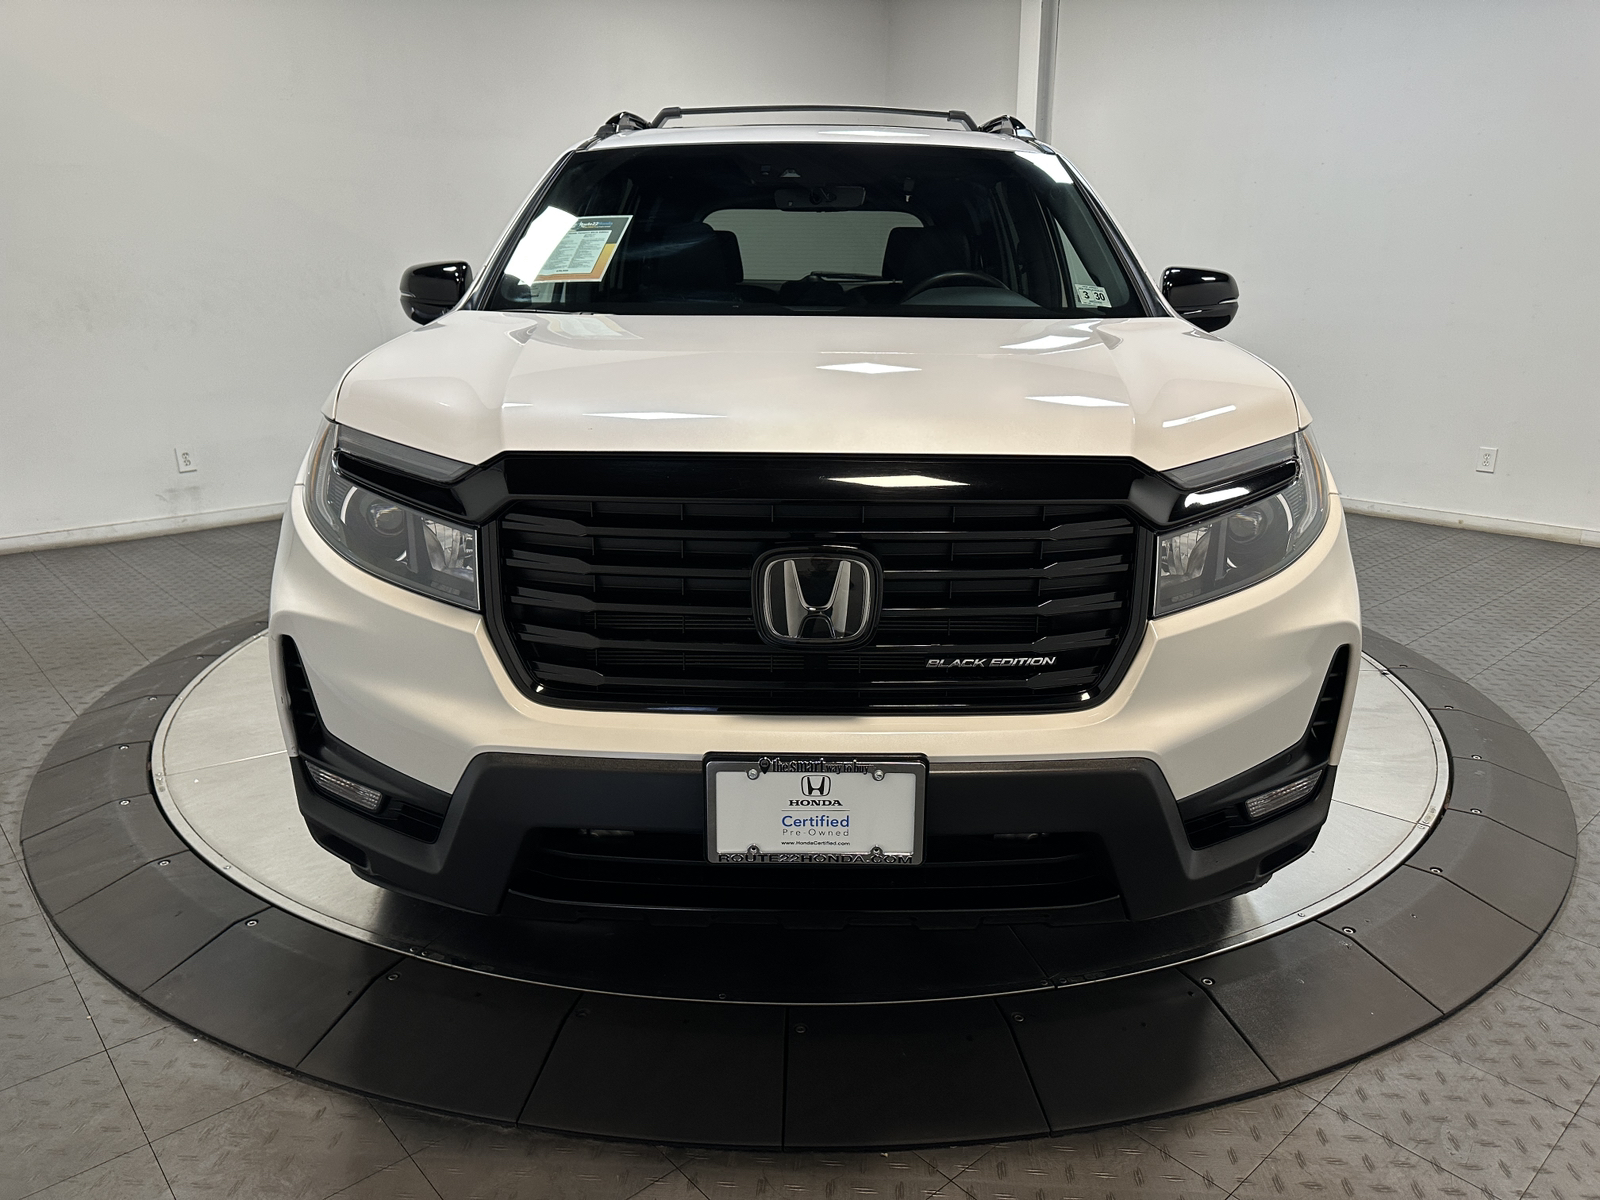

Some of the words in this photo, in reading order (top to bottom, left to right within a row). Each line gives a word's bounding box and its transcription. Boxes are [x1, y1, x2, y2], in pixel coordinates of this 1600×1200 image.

[1083, 291, 1089, 299] 3
[1094, 292, 1105, 301] 30
[926, 658, 986, 668] BLACK
[989, 656, 1056, 667] EDITION
[781, 815, 850, 827] Certified
[718, 854, 913, 863] ROUTE22HONDA.COM
